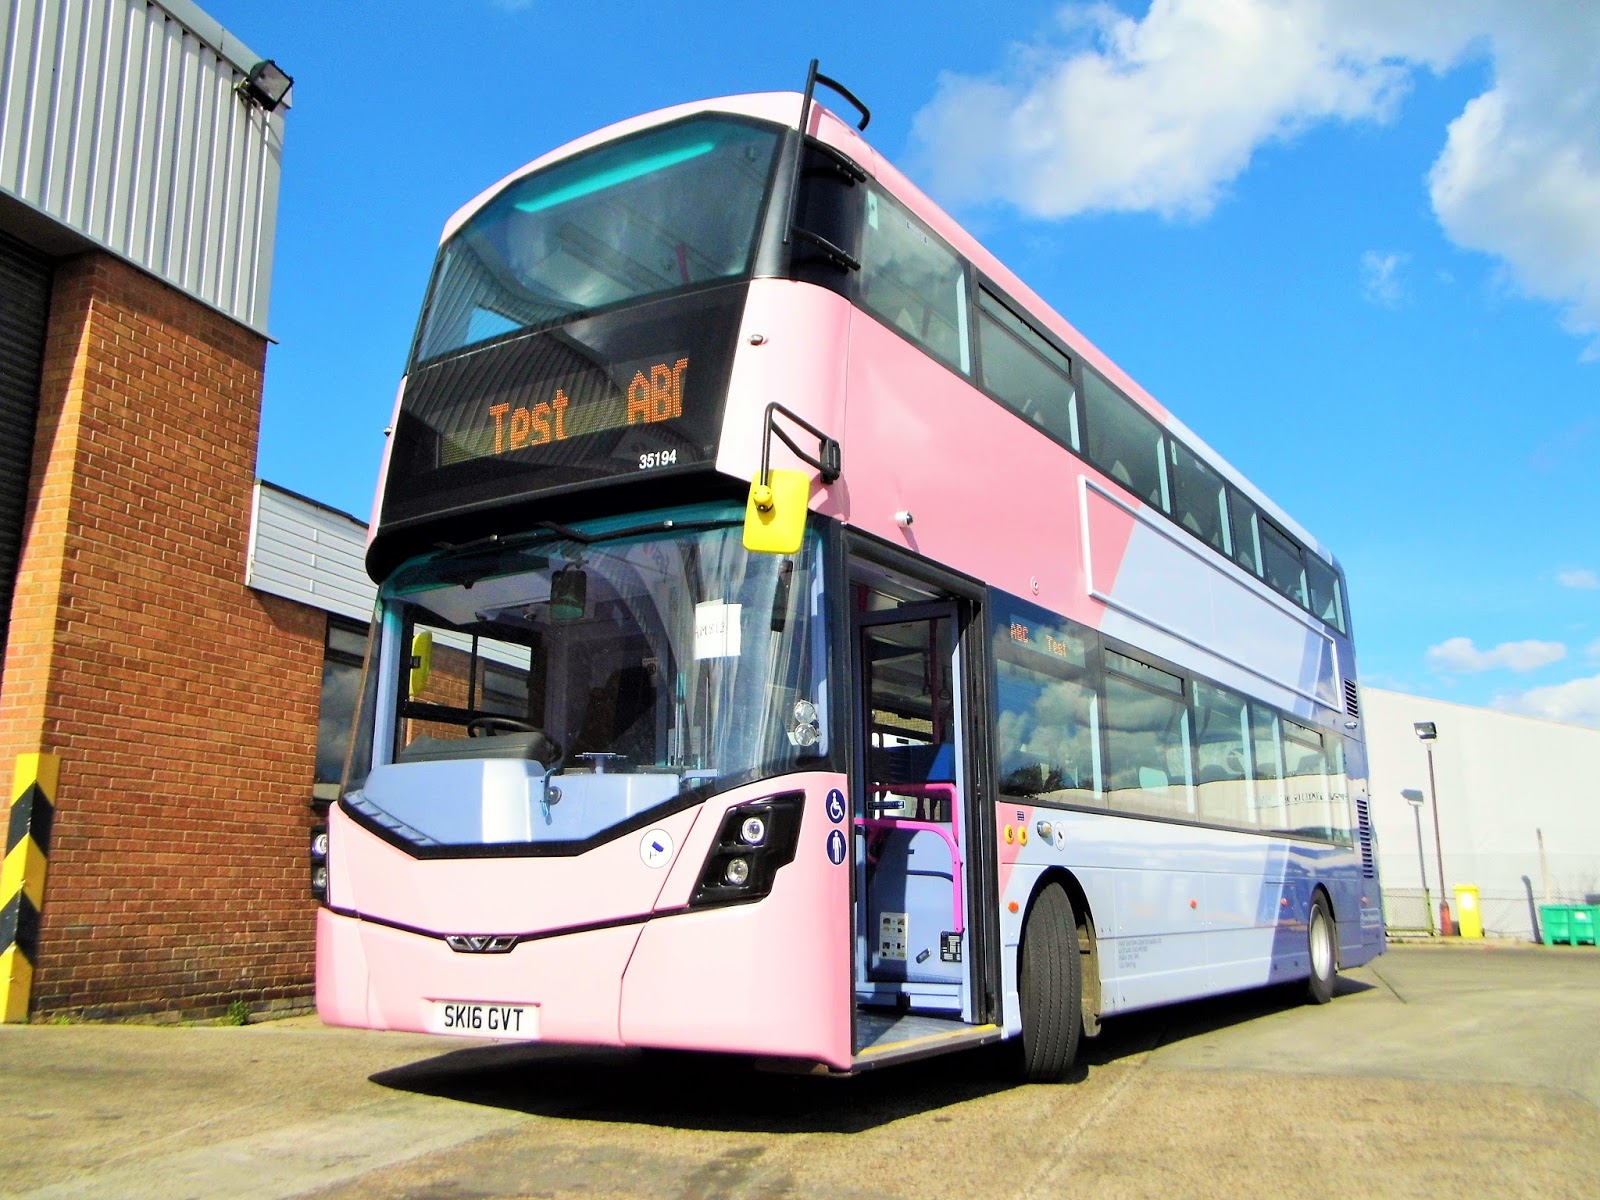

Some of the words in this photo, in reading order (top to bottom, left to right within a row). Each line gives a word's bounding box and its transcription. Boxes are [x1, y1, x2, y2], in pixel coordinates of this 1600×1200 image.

[489, 388, 569, 454] Test
[639, 449, 677, 469] 35194
[444, 1005, 482, 1029] SK16
[488, 1007, 524, 1031] GVT
